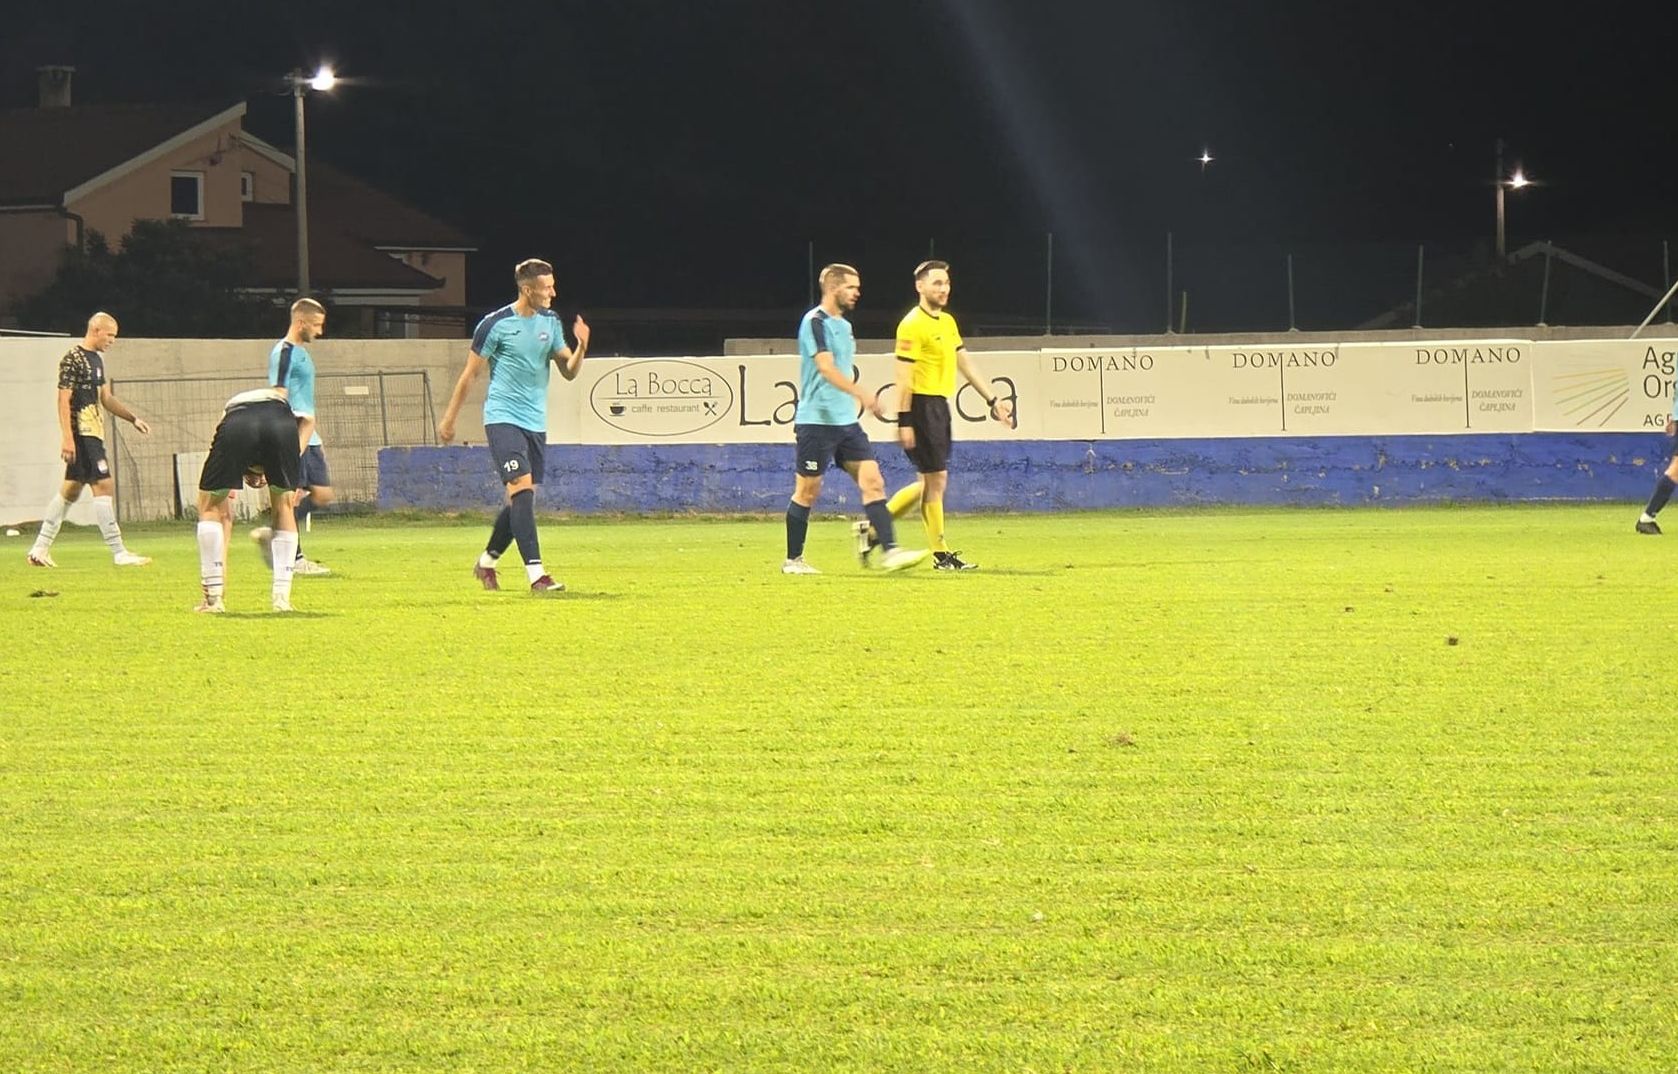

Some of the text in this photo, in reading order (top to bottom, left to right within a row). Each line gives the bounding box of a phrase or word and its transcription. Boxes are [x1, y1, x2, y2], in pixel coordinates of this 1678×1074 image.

[1052, 354, 1155, 373] DOMANO
[1232, 350, 1336, 369] DOMANO
[1415, 347, 1522, 366] DOMANO
[615, 371, 712, 397] La Bocca
[738, 364, 800, 427] La
[631, 403, 700, 413] caffe restaurant
[504, 459, 519, 473] 19
